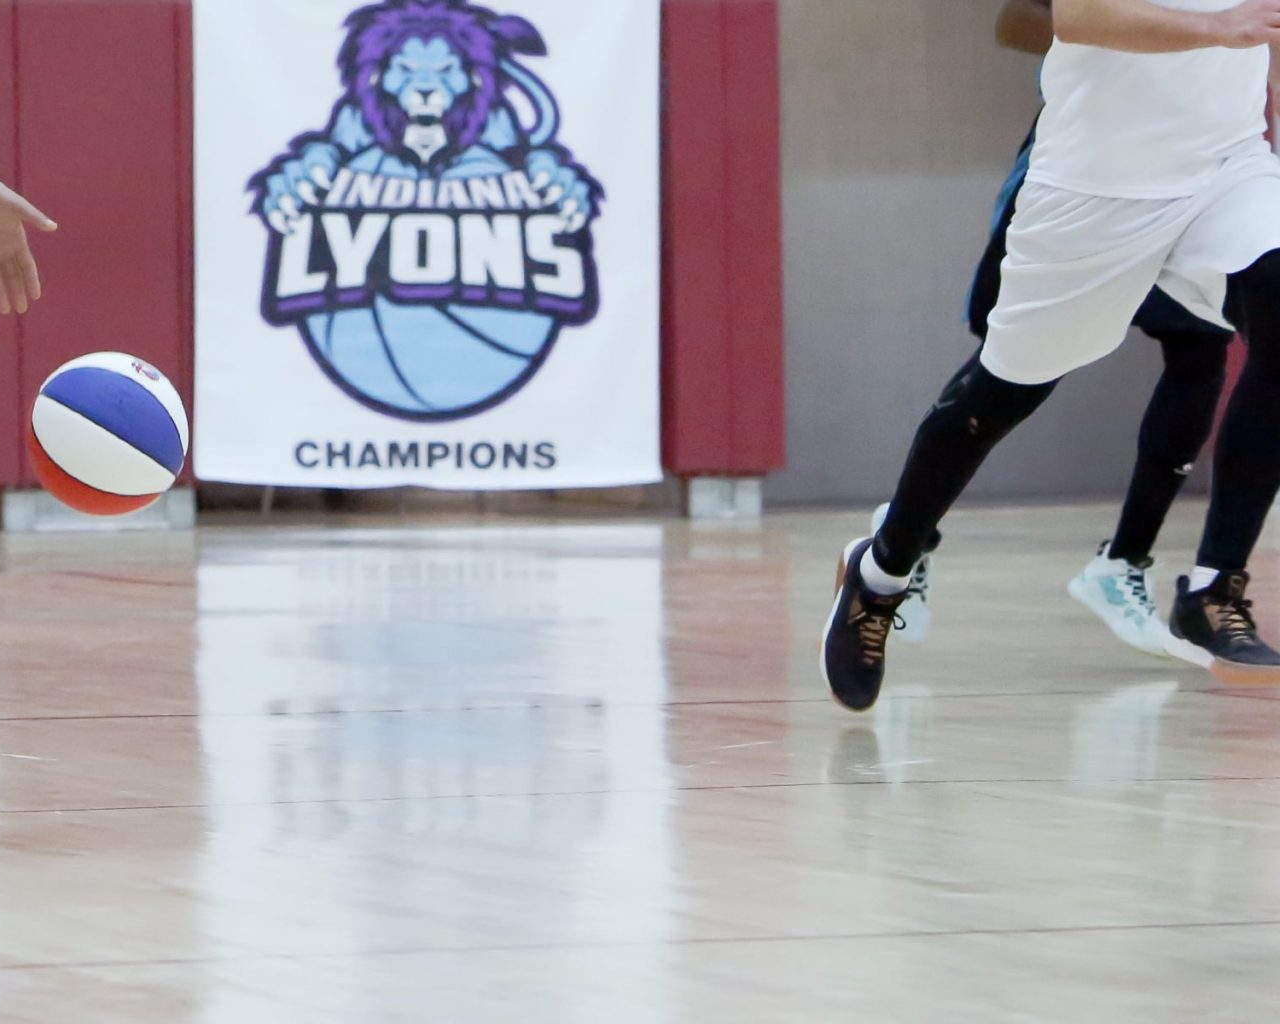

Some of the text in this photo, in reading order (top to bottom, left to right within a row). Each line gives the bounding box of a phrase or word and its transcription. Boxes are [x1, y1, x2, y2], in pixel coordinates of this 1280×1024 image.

[324, 168, 545, 210] INDIANA
[275, 212, 586, 299] LYONS
[294, 440, 558, 471] CHAMPIONS
